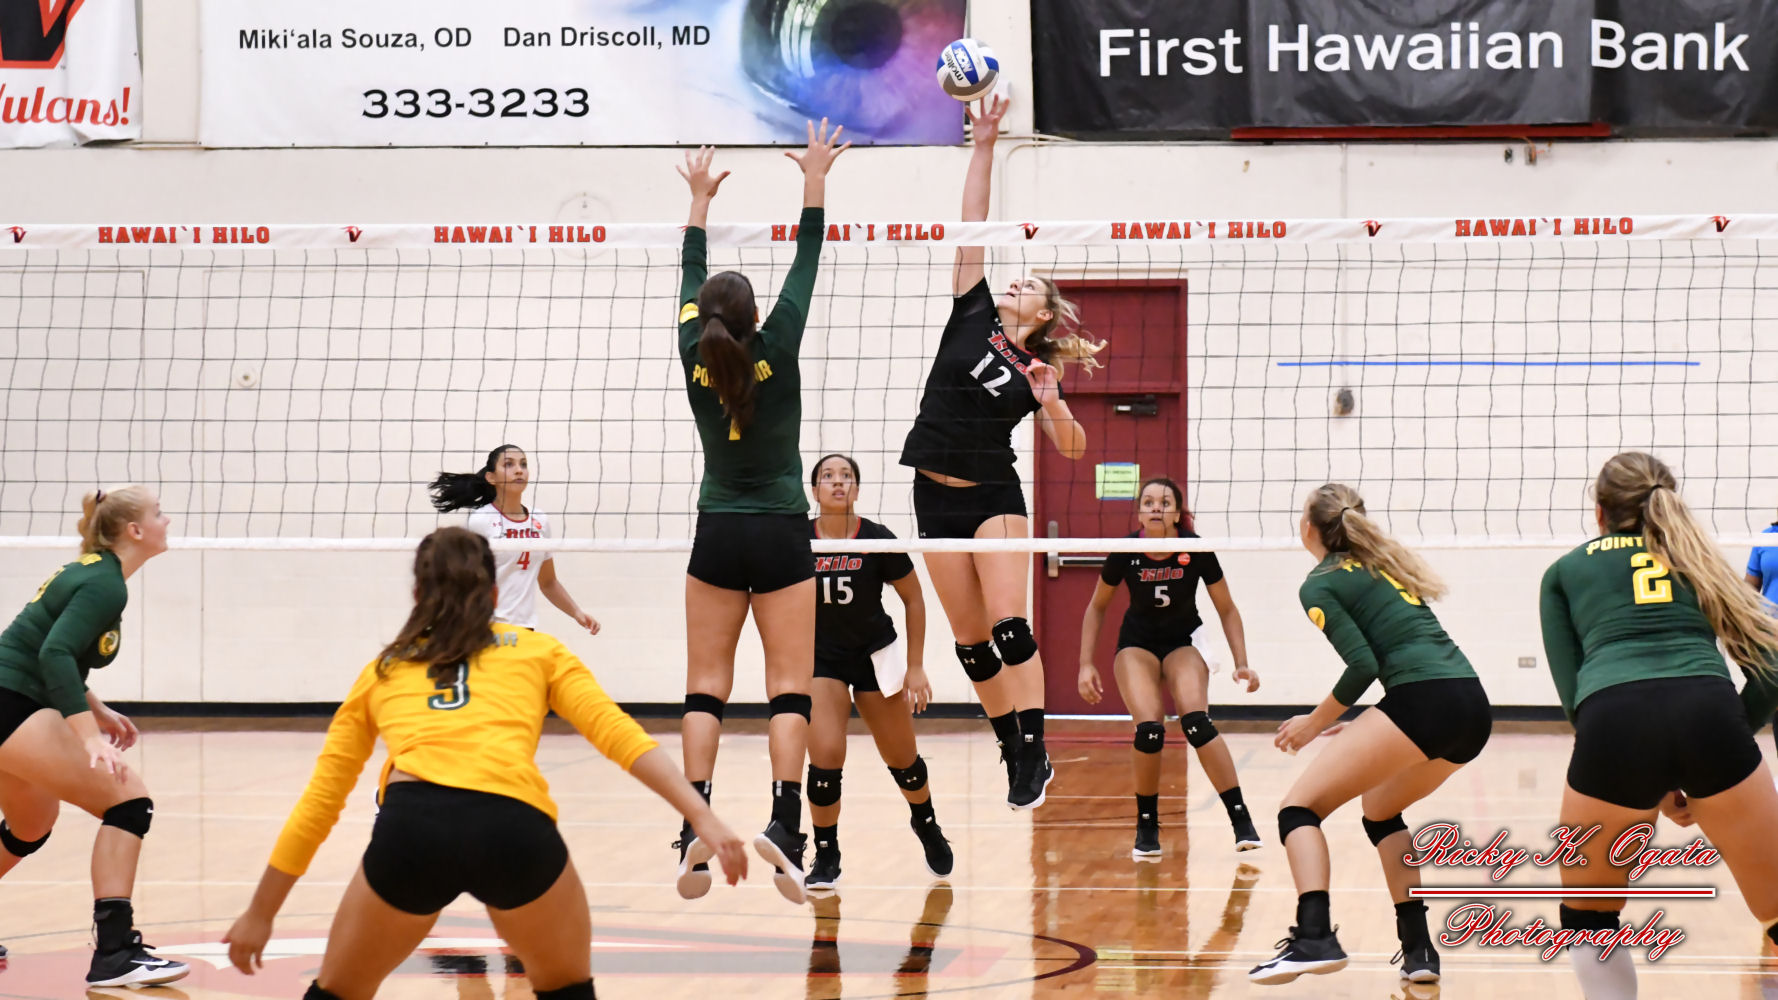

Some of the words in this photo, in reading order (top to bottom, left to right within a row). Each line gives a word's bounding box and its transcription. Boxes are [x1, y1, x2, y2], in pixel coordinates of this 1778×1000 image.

[342, 28, 424, 51] Souza,
[435, 28, 471, 48] OD
[504, 27, 550, 47] Dan
[562, 26, 662, 50] Driscoll,
[673, 25, 710, 46] MD
[1099, 28, 1243, 77] First
[1268, 21, 1563, 72] Hawaiian
[1591, 18, 1750, 72] Bank
[362, 87, 590, 119] 333-3233
[213, 226, 270, 244] HILO
[549, 225, 606, 244] HILO
[887, 223, 945, 241] HILO
[1228, 221, 1287, 239] HILO
[1574, 217, 1634, 235] HILO
[969, 351, 1011, 397] 12
[1586, 536, 1644, 556] POINT
[516, 551, 530, 571] 4
[814, 556, 863, 572] Hilo
[1138, 567, 1184, 582] Hilo
[1630, 552, 1674, 605] 2
[822, 576, 854, 605] 15
[1154, 585, 1171, 608] 5
[426, 658, 471, 711] 3
